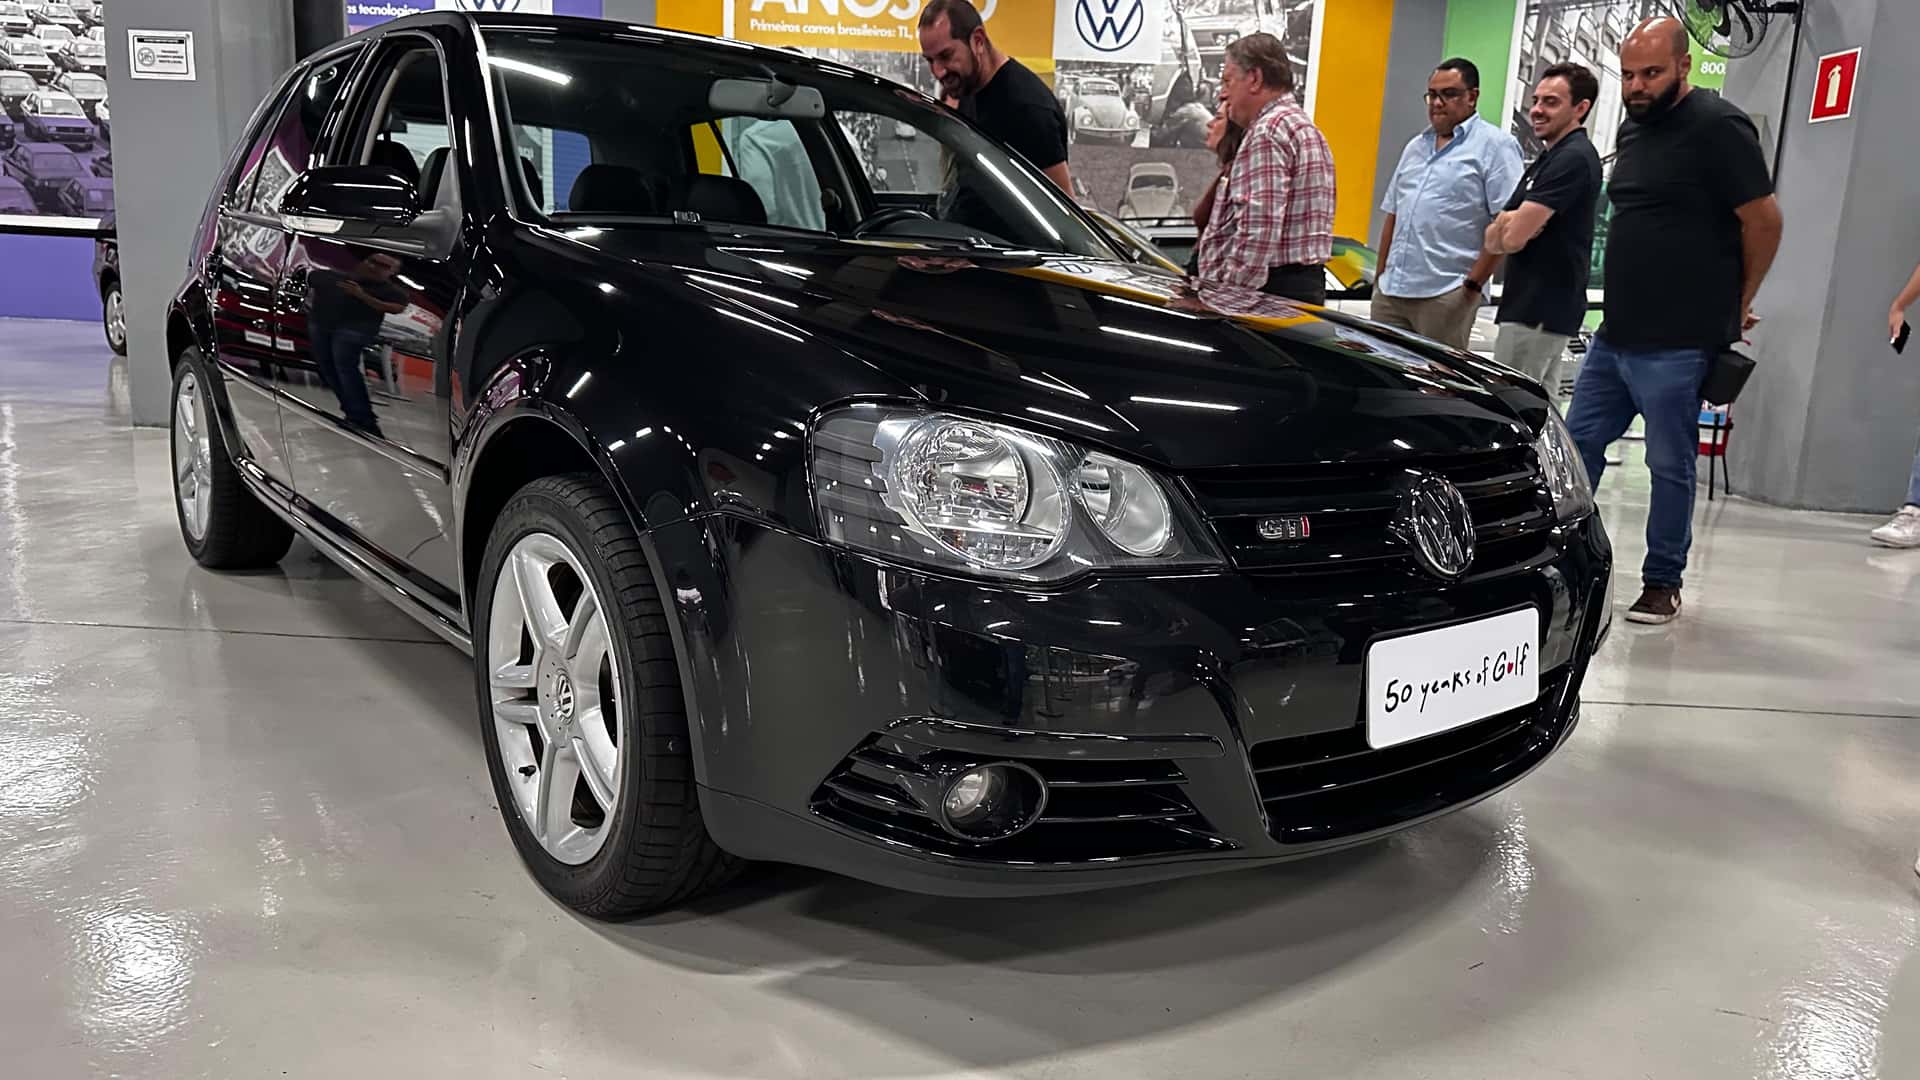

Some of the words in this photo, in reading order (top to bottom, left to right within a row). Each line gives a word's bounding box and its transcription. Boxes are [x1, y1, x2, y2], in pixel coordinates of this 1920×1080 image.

[750, 18, 800, 33] Primeiros
[802, 23, 835, 35] carros
[837, 22, 896, 39] brasileiros:
[1385, 680, 1412, 713] 50
[1476, 656, 1489, 686] of
